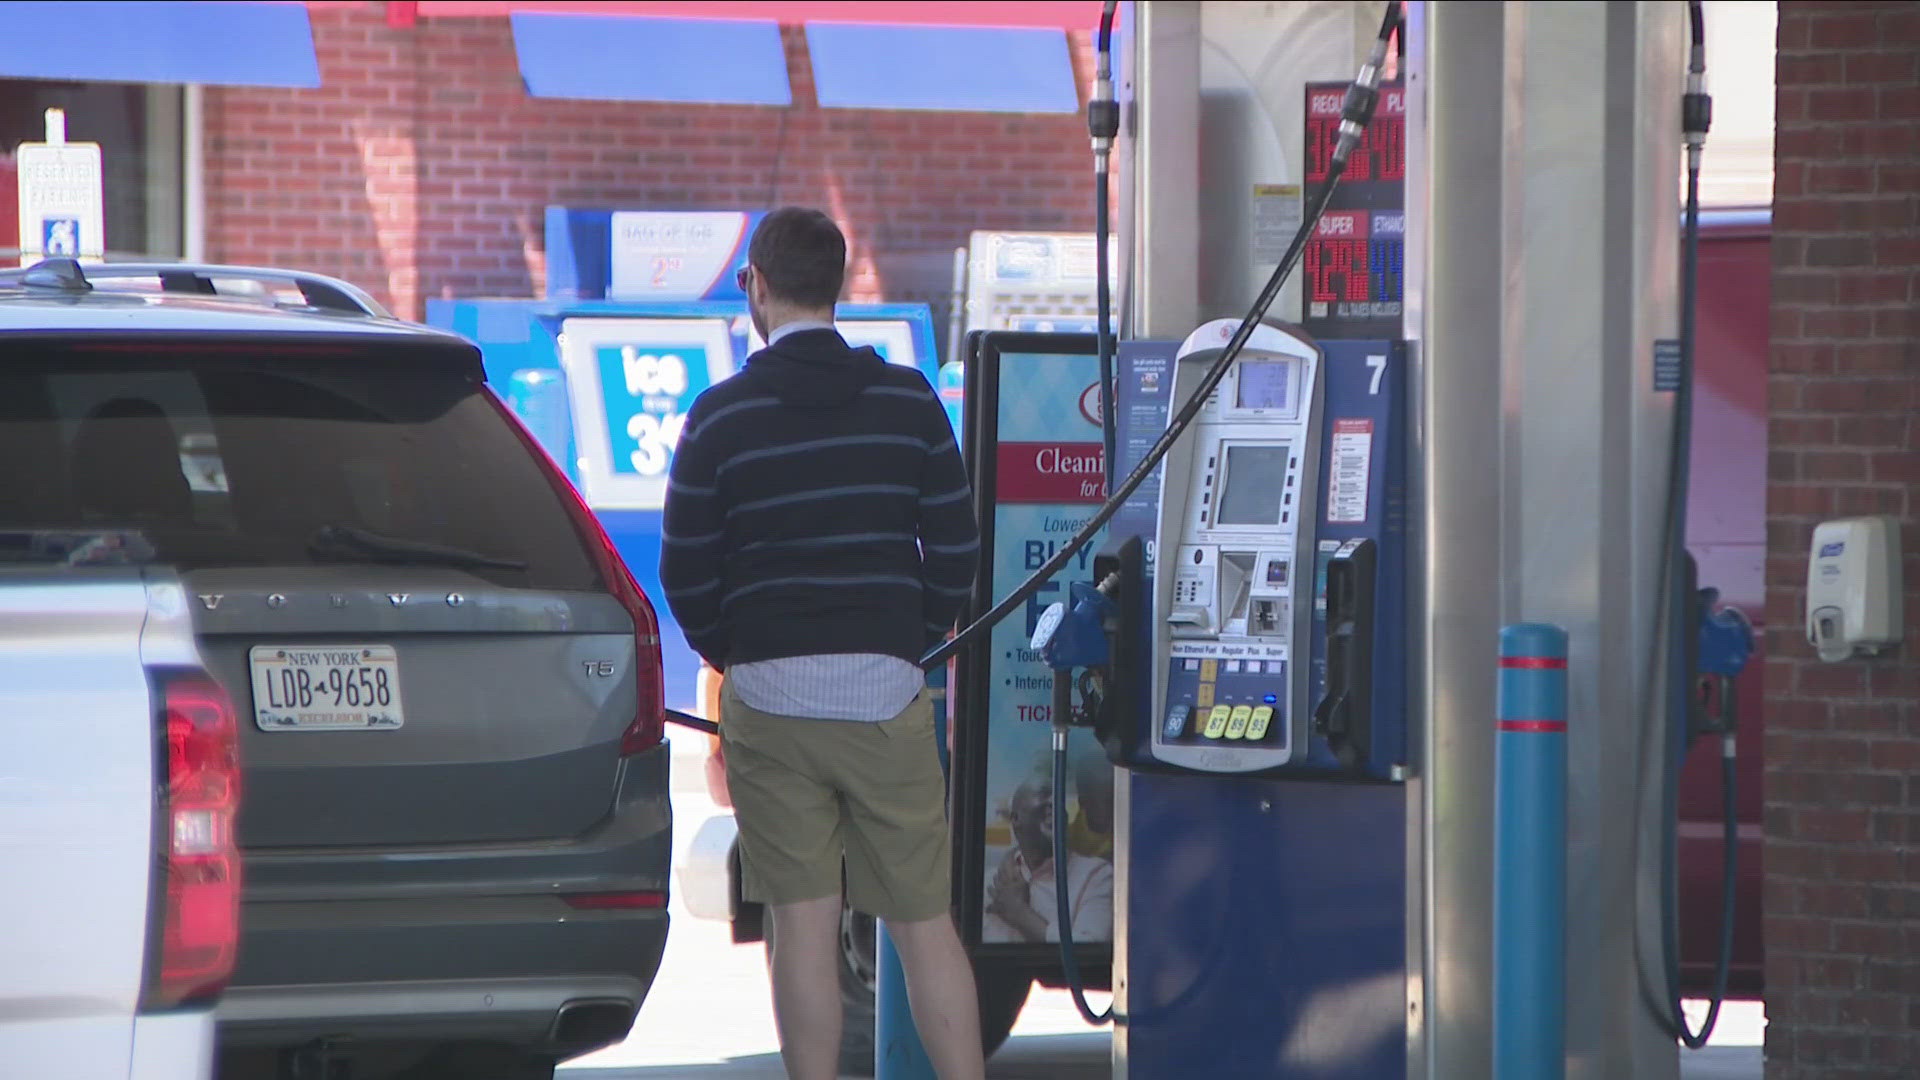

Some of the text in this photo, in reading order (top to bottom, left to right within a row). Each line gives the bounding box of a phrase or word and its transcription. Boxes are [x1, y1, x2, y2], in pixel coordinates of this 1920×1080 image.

[1318, 216, 1354, 234] SUPER
[1366, 355, 1387, 395] 7
[1080, 480, 1099, 497] for
[198, 593, 465, 611] VOLVO
[1205, 645, 1217, 654] Fuel
[1222, 646, 1244, 656] Regular
[1247, 646, 1260, 655] Plus
[1266, 647, 1283, 656] Super
[288, 653, 360, 665] NEW YORK
[583, 661, 614, 678] T5
[266, 667, 390, 708] LDB 9658
[1168, 717, 1182, 731] 90
[1210, 717, 1224, 731] 87
[1252, 718, 1265, 732] 93
